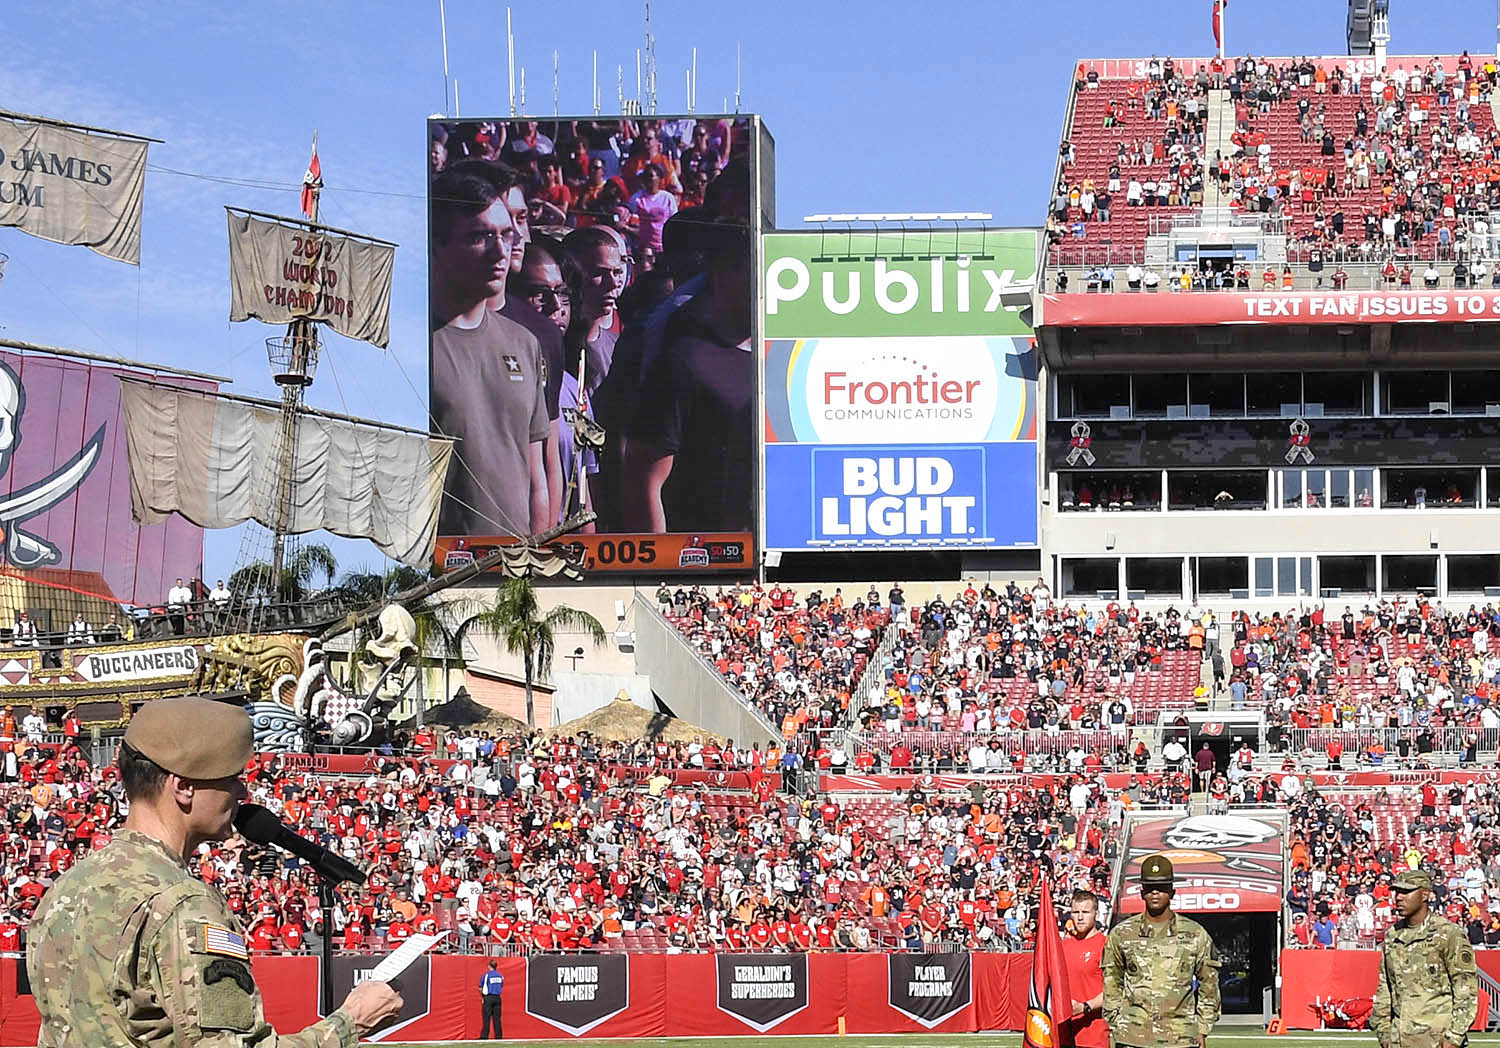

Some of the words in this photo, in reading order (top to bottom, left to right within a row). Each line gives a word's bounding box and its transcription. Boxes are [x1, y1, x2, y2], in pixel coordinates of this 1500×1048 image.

[11, 148, 112, 186] JAMES
[284, 257, 337, 288] WORLD
[766, 256, 1018, 315] Publix
[1244, 298, 1302, 316] TEXT
[1310, 297, 1357, 316] FAN
[1363, 296, 1448, 315] ISSUES
[1455, 296, 1485, 315] TO
[824, 371, 981, 405] Frontier
[824, 408, 973, 421] COMMUNICATIONS
[843, 457, 954, 496] BUD
[89, 648, 196, 679] BUCCANEERS
[557, 966, 598, 983] FAMOUS
[915, 965, 946, 981] PLAYER
[731, 983, 795, 999] SUPERHEROES
[909, 982, 952, 997] PROGRAMS
[1267, 1021, 1279, 1034] G
